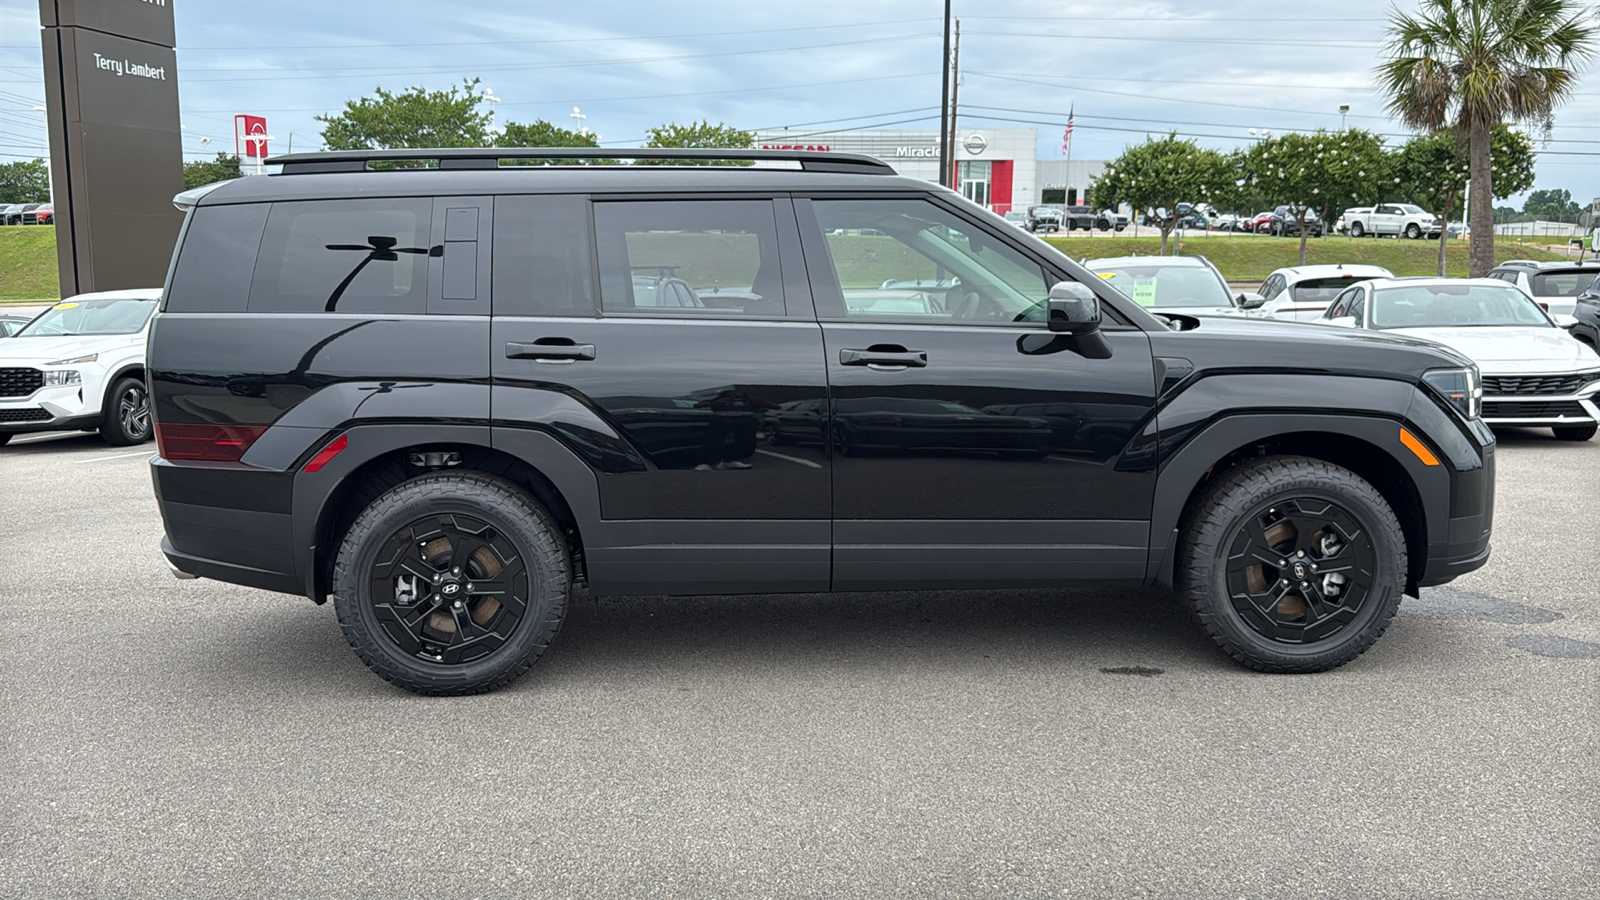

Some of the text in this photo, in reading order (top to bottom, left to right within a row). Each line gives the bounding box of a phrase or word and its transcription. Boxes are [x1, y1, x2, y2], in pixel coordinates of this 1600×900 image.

[93, 52, 166, 81] Terry Lambert
[1242, 479, 1345, 511] CONTINENTAL
